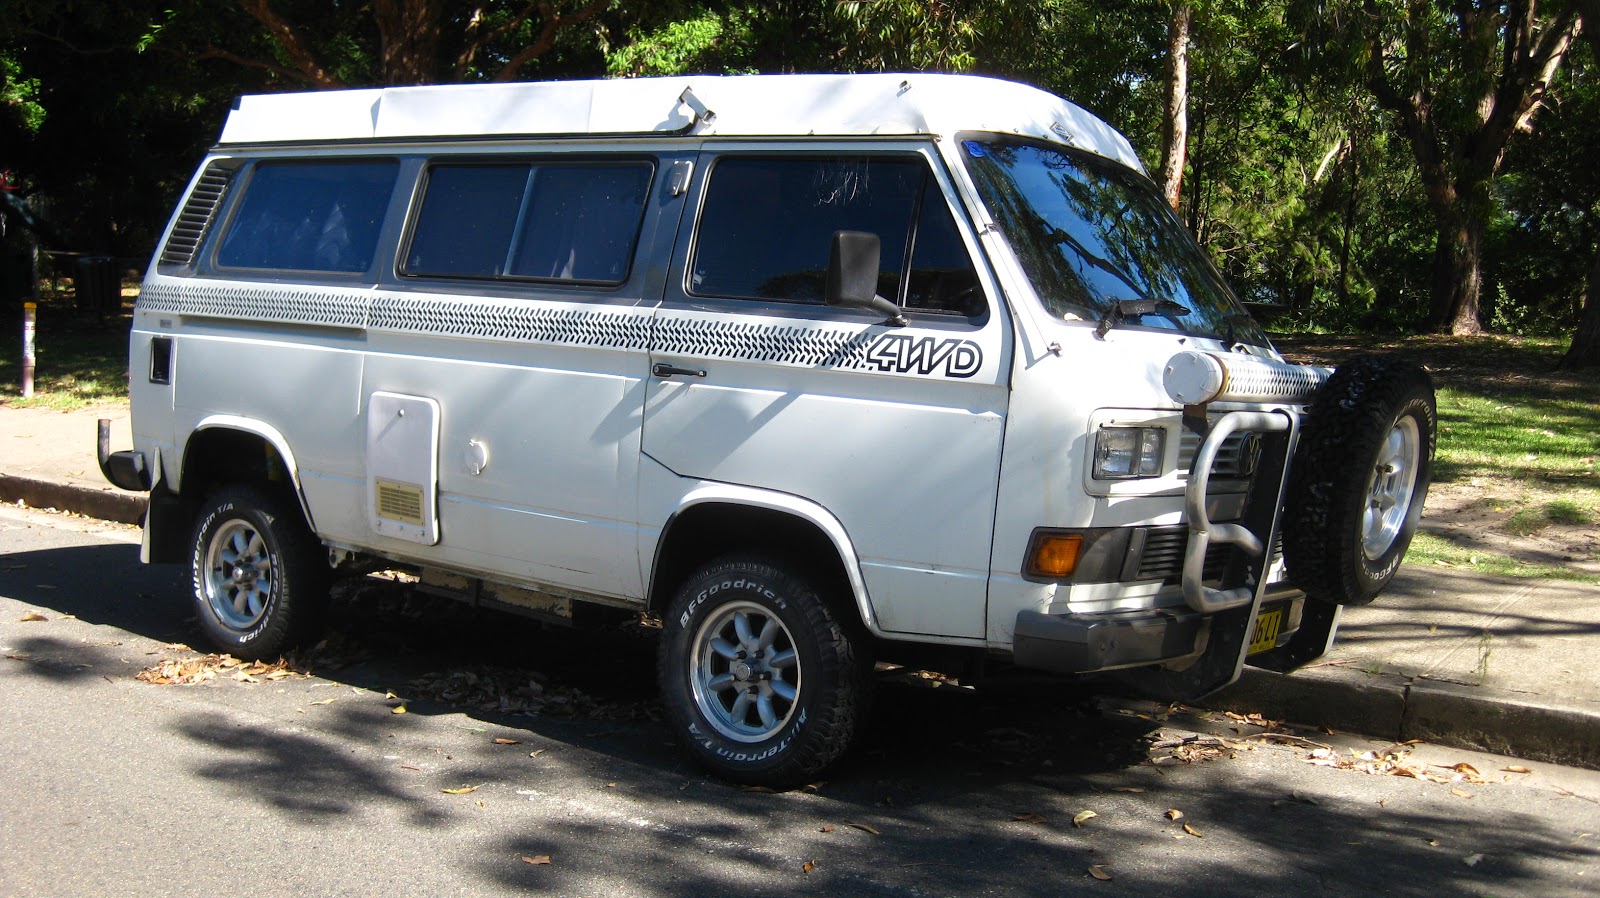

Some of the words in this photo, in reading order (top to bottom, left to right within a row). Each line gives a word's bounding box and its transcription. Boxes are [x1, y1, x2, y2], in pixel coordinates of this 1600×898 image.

[866, 334, 983, 378] 4WD
[192, 512, 216, 602] All-Terrain
[217, 502, 234, 514] T/A
[679, 578, 787, 629] BFGoodrich
[716, 706, 808, 763] All-Terrain
